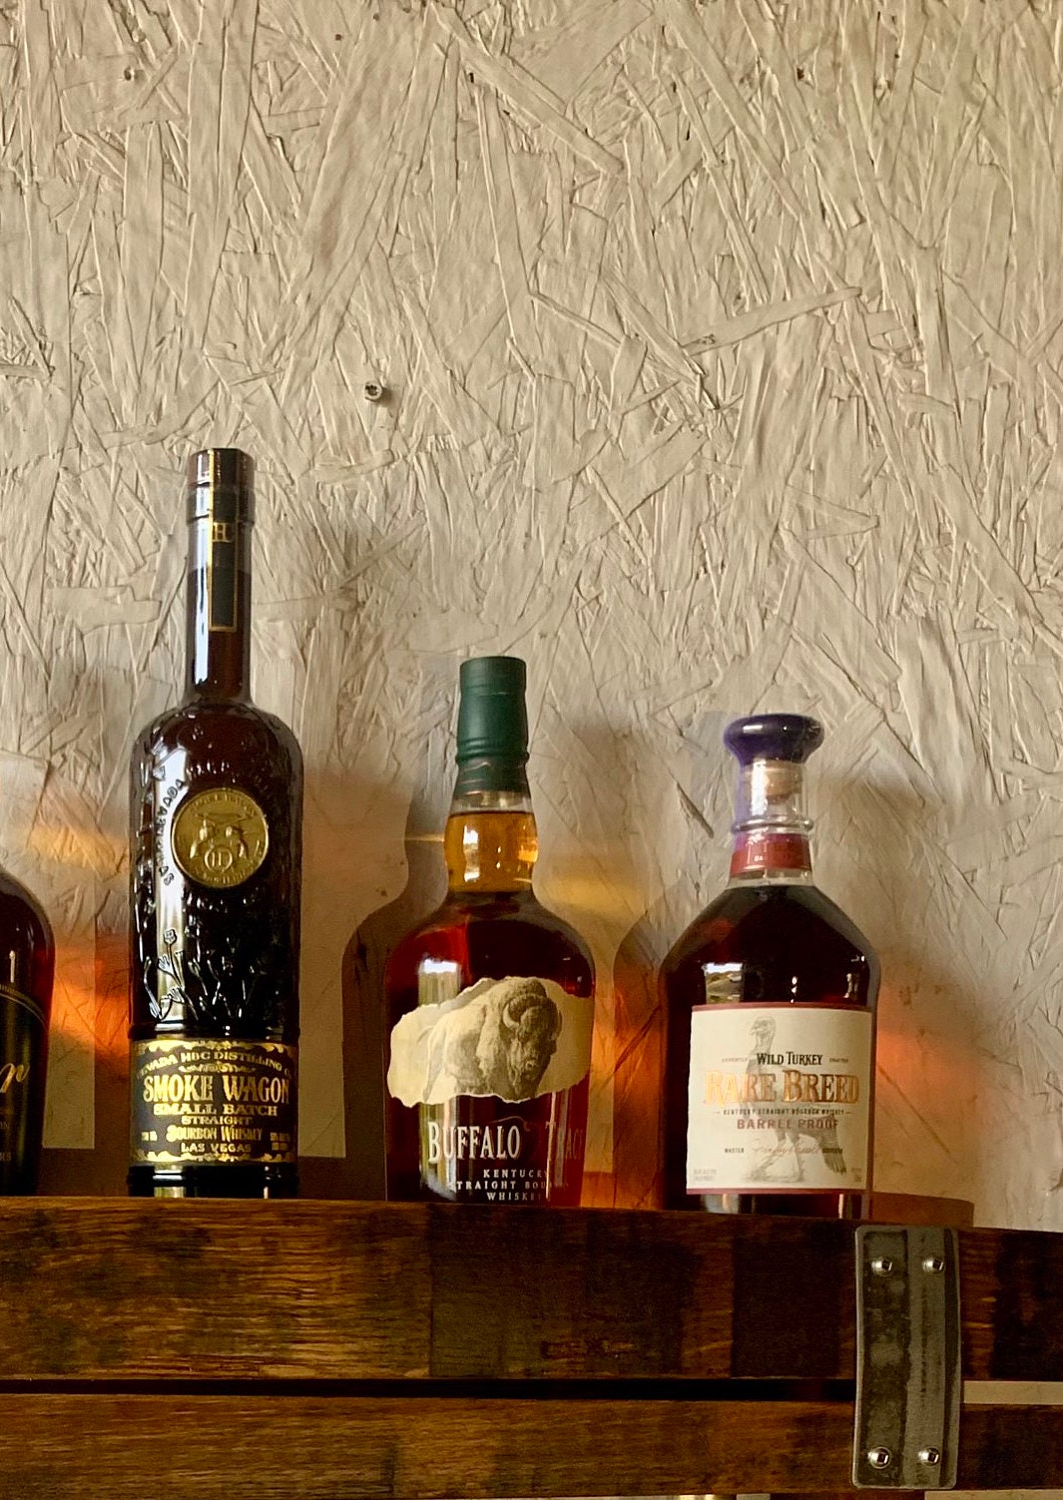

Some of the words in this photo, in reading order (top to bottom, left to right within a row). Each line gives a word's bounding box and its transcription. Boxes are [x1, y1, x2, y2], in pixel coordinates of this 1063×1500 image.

[213, 1052, 283, 1071] DISTILLING
[756, 1053, 784, 1065] WILD
[786, 1051, 824, 1066] TURKEY
[143, 1074, 214, 1103] SMOKE
[221, 1075, 290, 1105] WAGON
[704, 1069, 777, 1107] RARE
[781, 1069, 861, 1105] BREED
[153, 1103, 217, 1116] SMALL
[223, 1103, 278, 1117] BATCH
[181, 1115, 253, 1125] STRAIGHT
[737, 1118, 791, 1130] BARREL
[798, 1118, 839, 1130] PROOF
[166, 1124, 217, 1142] BOURBON
[181, 1142, 205, 1152] LAS
[210, 1142, 252, 1153] VEGAS
[428, 1121, 521, 1165] BUFFALO
